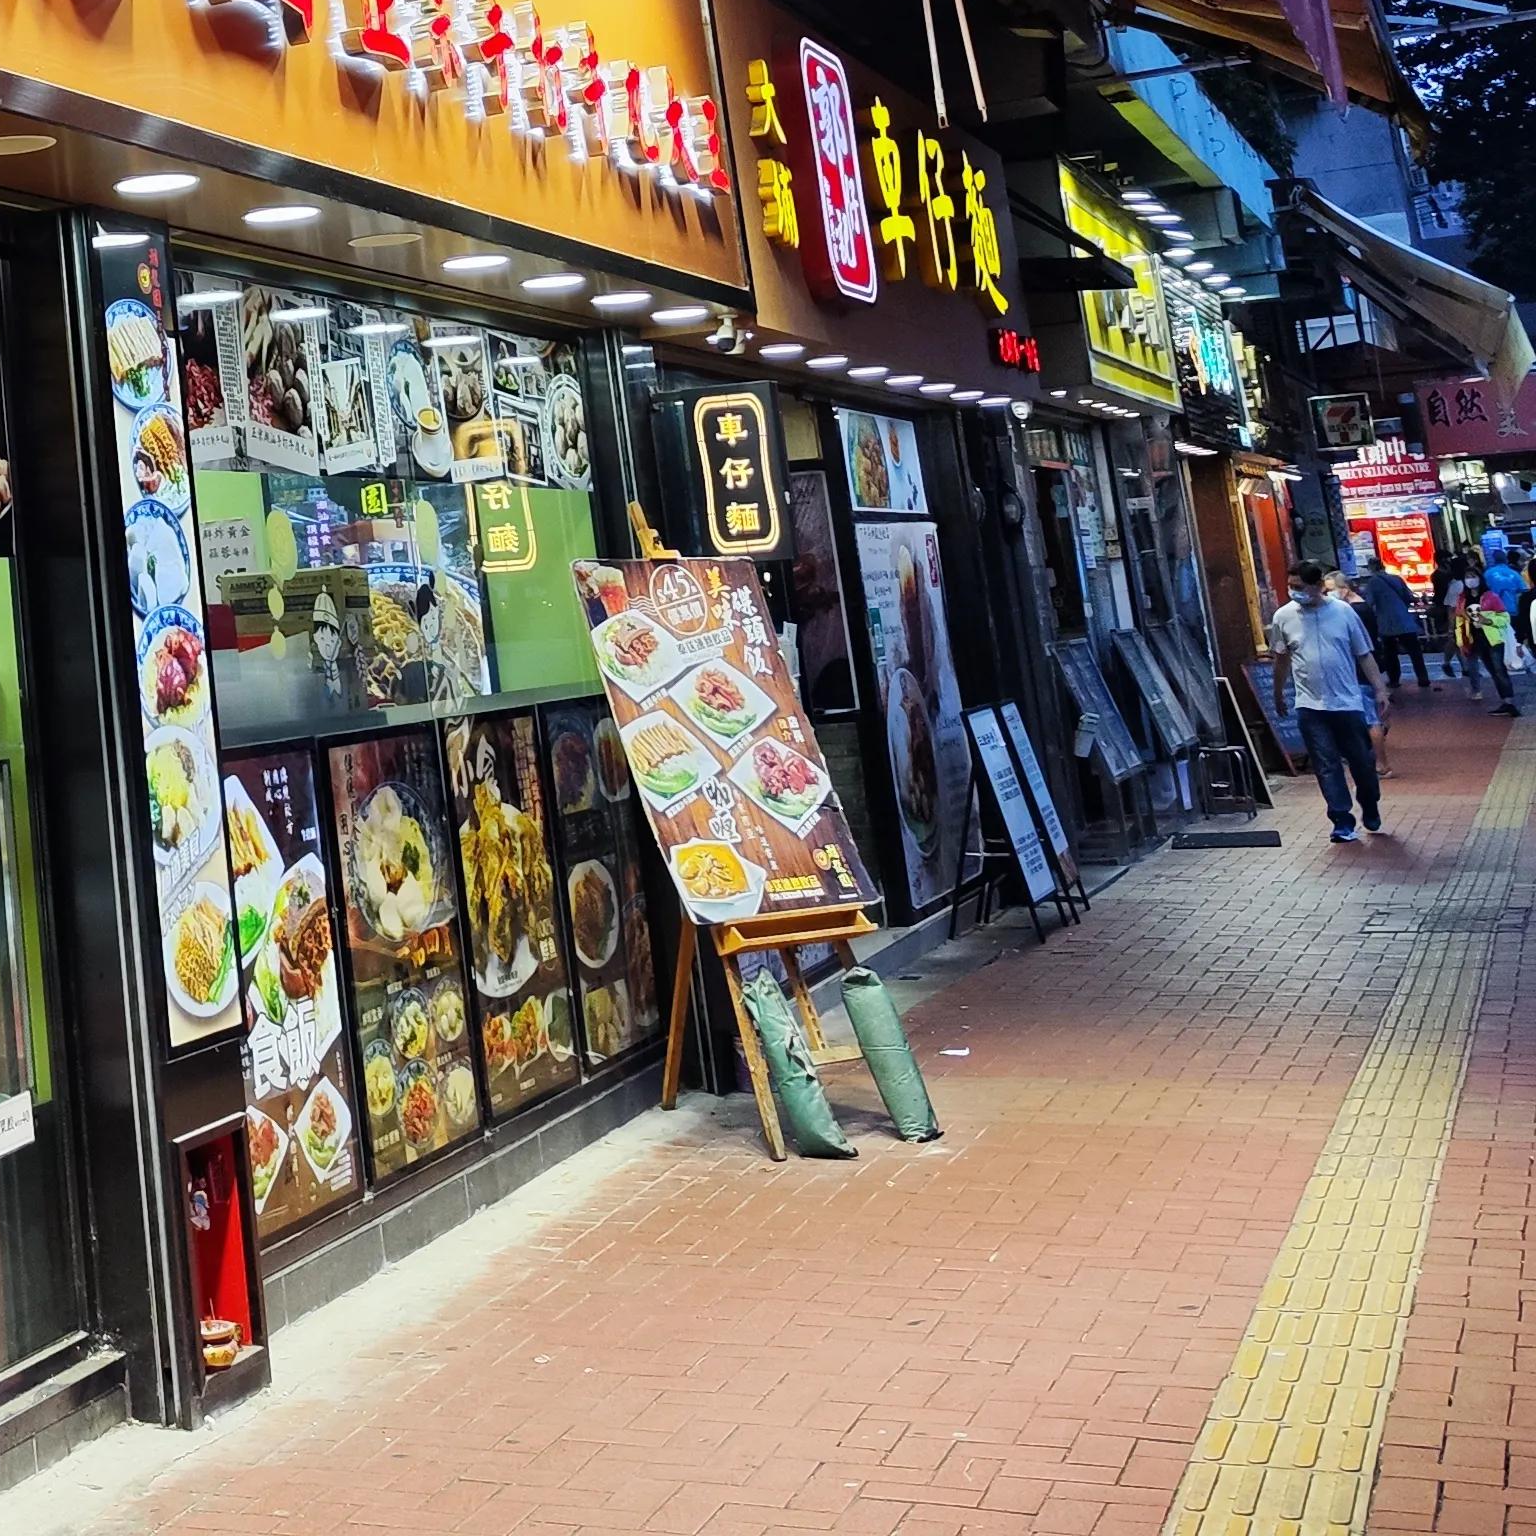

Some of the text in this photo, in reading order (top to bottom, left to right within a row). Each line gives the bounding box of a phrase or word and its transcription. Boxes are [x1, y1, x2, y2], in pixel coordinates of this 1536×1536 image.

[871, 95, 1009, 315] 車仔麵
[716, 412, 761, 537] 車仔麵
[1399, 462, 1431, 476] CENTRE
[705, 565, 741, 631] 美味
[731, 585, 774, 677] 碟頭飯
